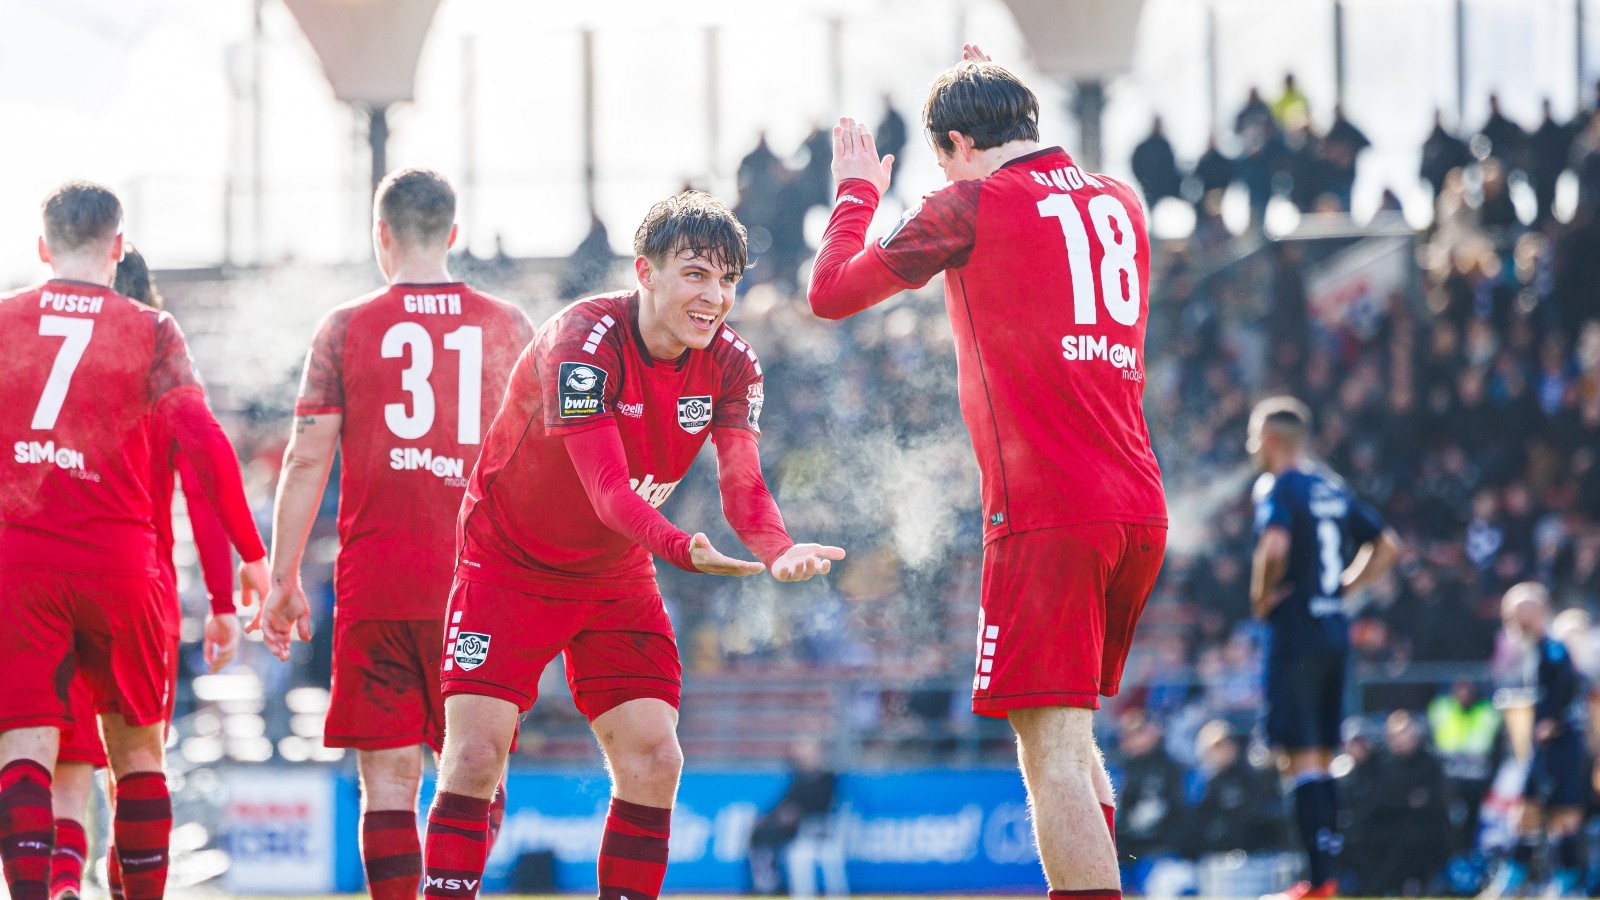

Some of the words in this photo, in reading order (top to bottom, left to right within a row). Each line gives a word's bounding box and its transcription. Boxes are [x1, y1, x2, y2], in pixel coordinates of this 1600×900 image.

[1036, 193, 1141, 327] 18
[39, 291, 104, 313] PUSCH
[403, 293, 462, 315] GIRTH
[1061, 335, 1136, 370] SIMON
[31, 315, 94, 430] 7
[381, 321, 483, 445] 31
[564, 395, 599, 409] bwin
[14, 440, 84, 470] SIMON
[390, 447, 464, 477] SIMON
[427, 875, 478, 891] MSV
